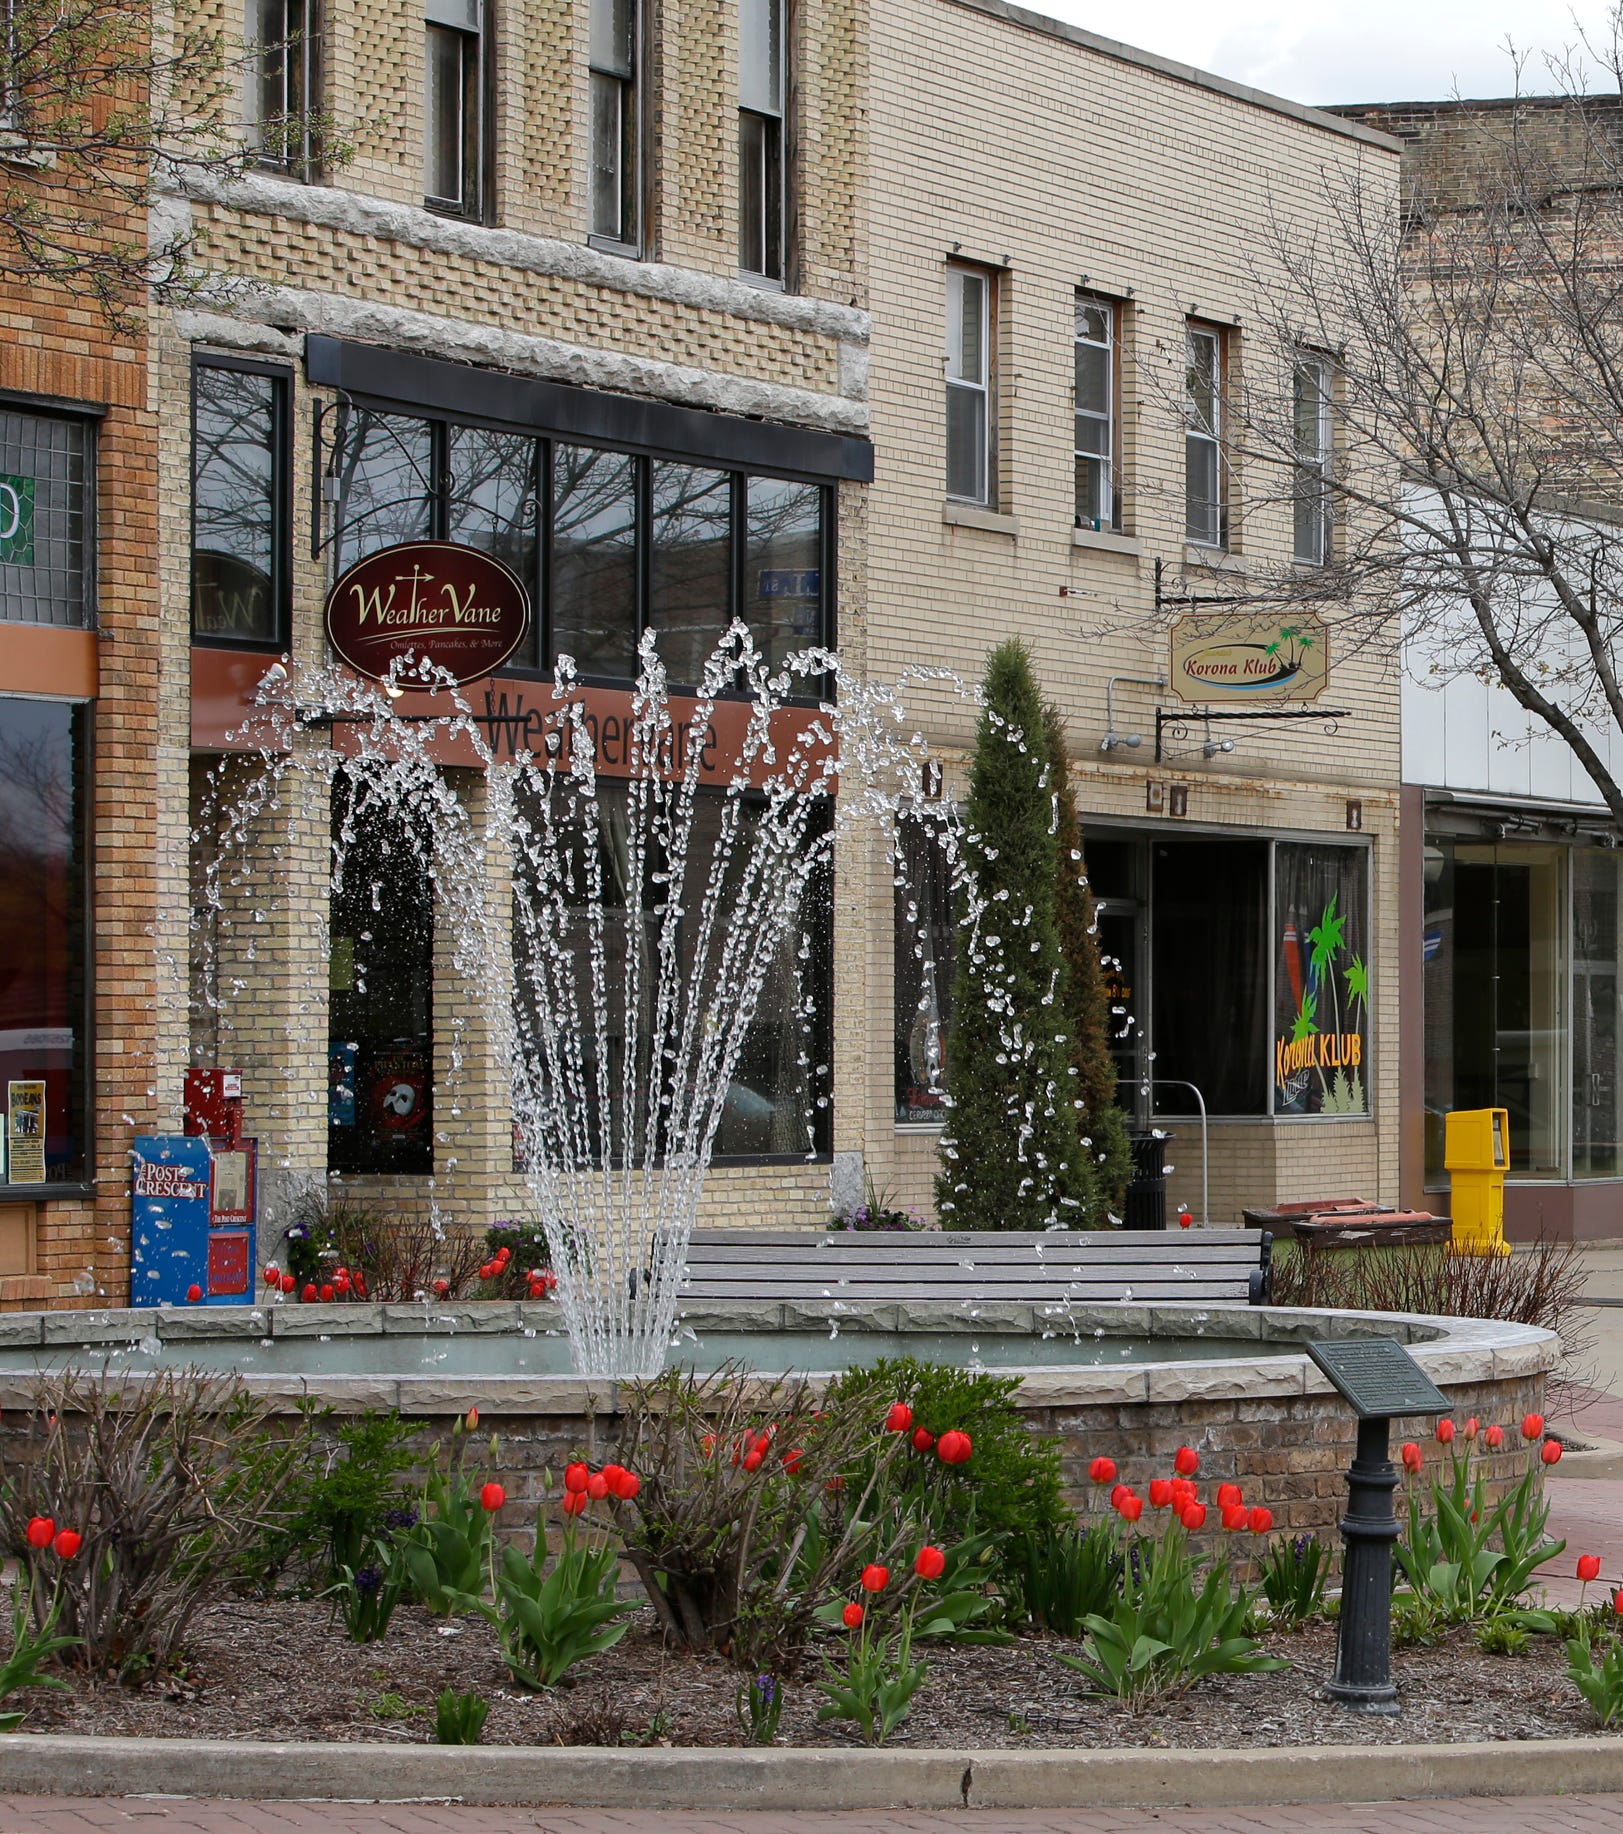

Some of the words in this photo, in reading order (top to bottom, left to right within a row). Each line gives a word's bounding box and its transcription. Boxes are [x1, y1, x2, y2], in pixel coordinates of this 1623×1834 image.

[1186, 659, 1237, 676] Korona
[1243, 657, 1277, 675] Klub
[1276, 1034, 1316, 1090] Korona
[1320, 1033, 1361, 1067] KLUB
